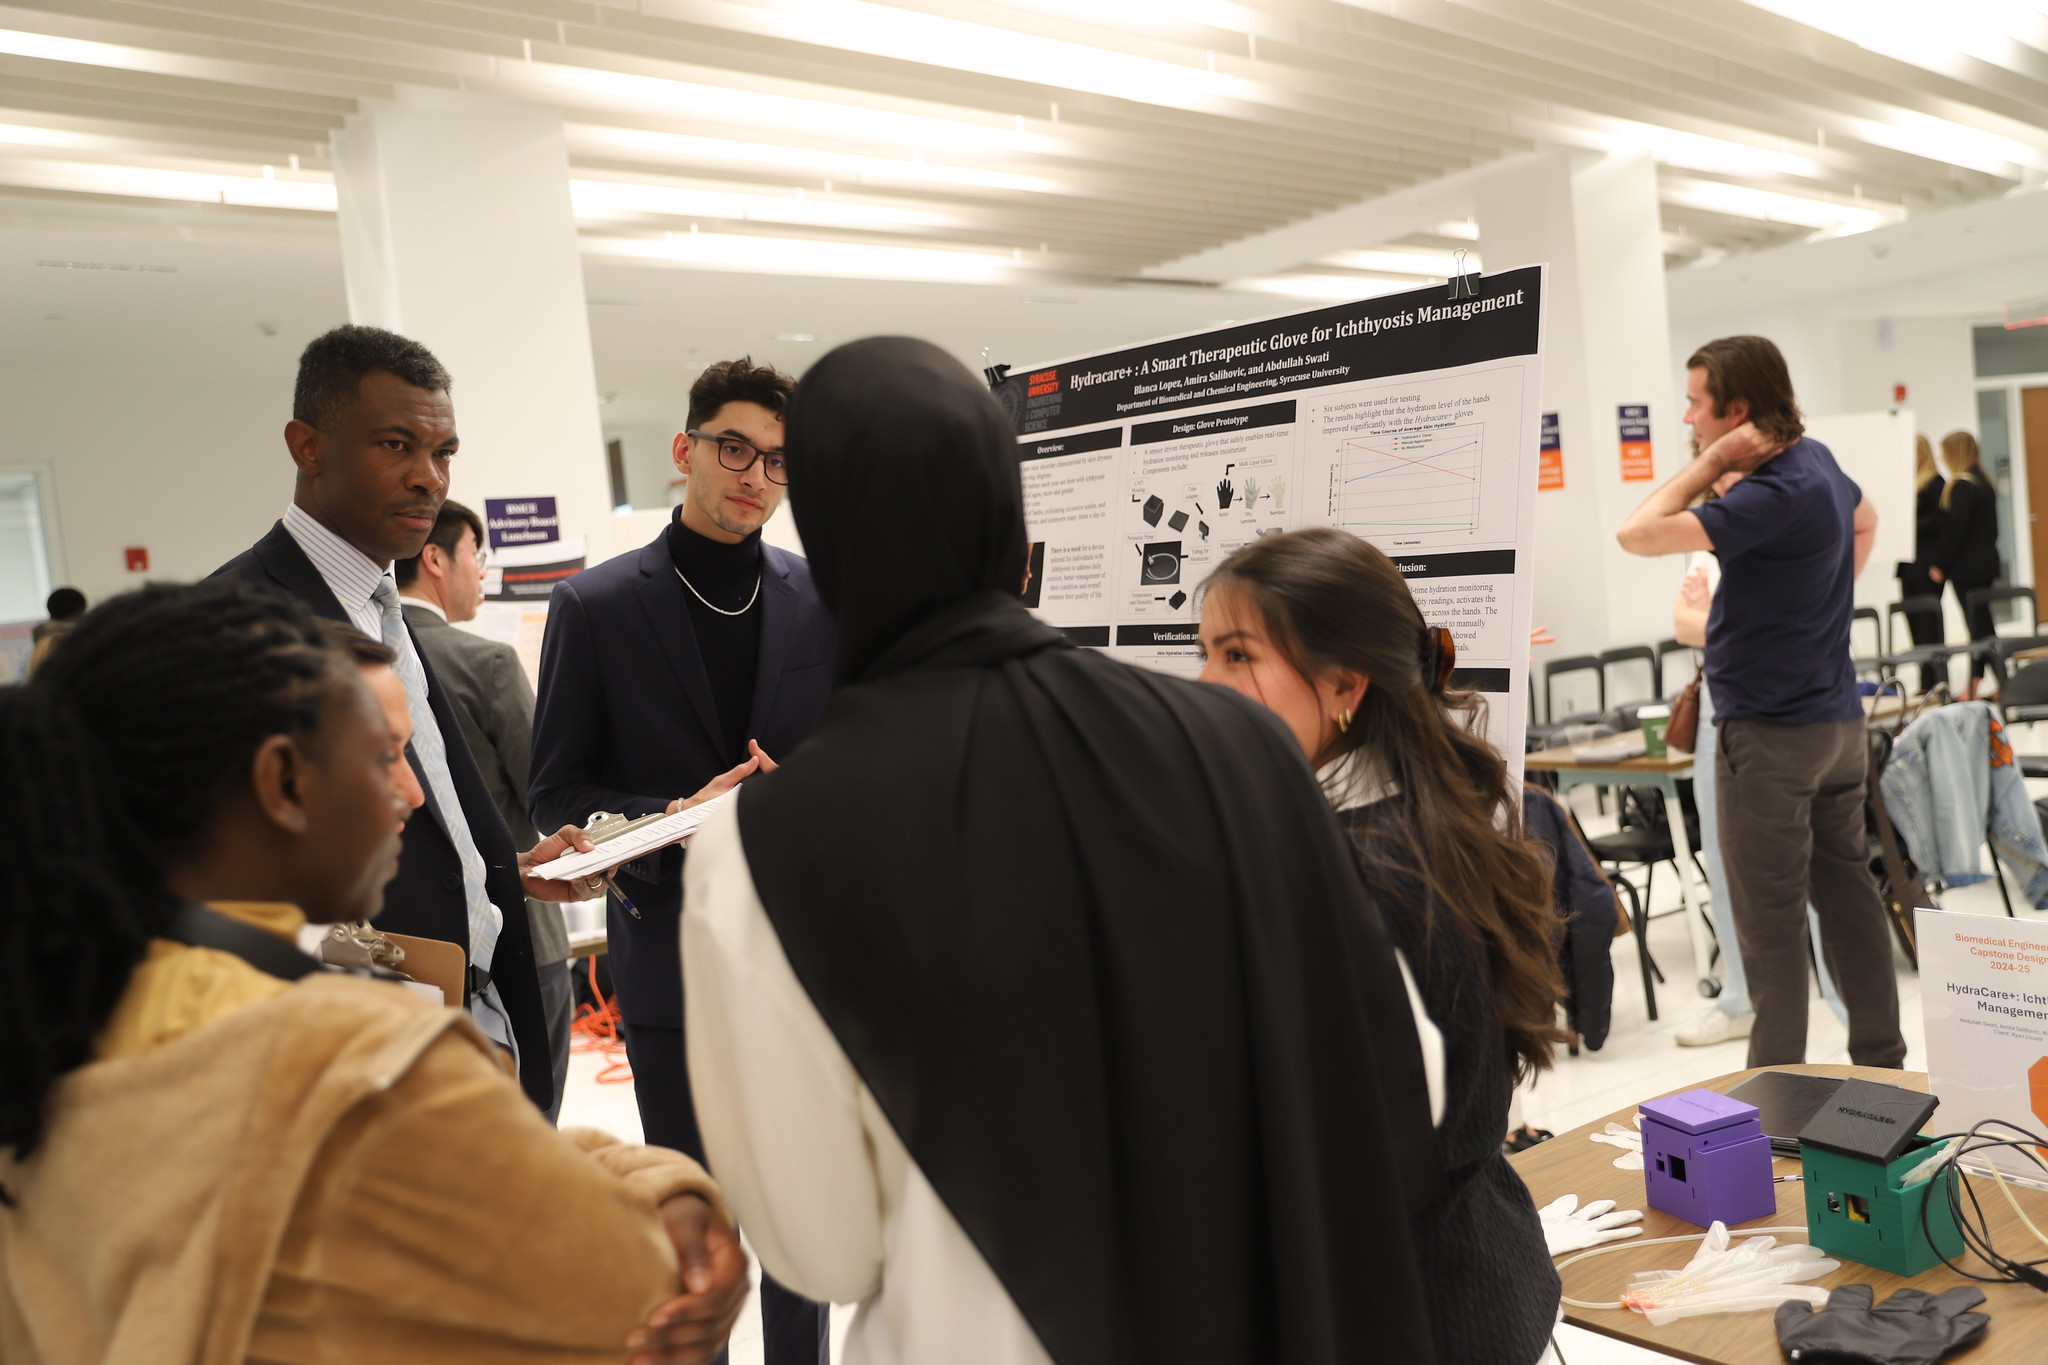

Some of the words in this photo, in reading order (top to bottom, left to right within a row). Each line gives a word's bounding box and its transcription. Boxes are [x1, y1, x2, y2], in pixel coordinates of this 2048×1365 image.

[1070, 366, 1132, 392] Hydracare+
[1141, 361, 1150, 375] A
[1152, 356, 1187, 374] Smart
[1190, 338, 1267, 366] Therapeutic
[1270, 333, 1308, 350] Glove
[1311, 326, 1332, 343] for
[1336, 310, 1414, 339] Ichthyosis
[1417, 289, 1524, 324] Management
[1029, 370, 1056, 386] SYRACUSE
[1134, 381, 1158, 396] Blanca
[1159, 376, 1183, 390] Lopez,
[1184, 374, 1208, 386] Amira
[1209, 367, 1246, 382] Salihovic,
[1248, 363, 1264, 374] and
[1265, 356, 1303, 372] Abdullah
[1305, 351, 1330, 365] Swati
[1028, 381, 1060, 397] UNIVERSITY
[1116, 398, 1150, 412] Department
[1151, 397, 1158, 406] of
[1159, 391, 1192, 404] Biomedical
[1193, 389, 1205, 399] and
[1206, 384, 1236, 397] Chemical
[1279, 372, 1310, 386] Syracuse
[1312, 365, 1350, 378] University
[1334, 402, 1357, 413] subjects
[1400, 394, 1420, 404] testing
[1334, 413, 1353, 422] results
[1355, 410, 1381, 421] highlight
[1407, 403, 1437, 415] hydration
[1438, 401, 1453, 410] level
[1462, 398, 1472, 406] the
[1472, 394, 1490, 404] hands
[1172, 424, 1196, 434] Design:
[1197, 420, 1215, 430] Glove
[1216, 415, 1249, 427] Prototype
[1322, 425, 1349, 435] improved
[1350, 420, 1386, 433] significantly
[1388, 418, 1402, 426] with
[1414, 413, 1453, 426] Hydracare+
[1454, 410, 1474, 420] gloves
[1037, 444, 1064, 454] Overview:
[1179, 442, 1204, 452] therapeutic
[1205, 439, 1218, 448] glove
[1230, 435, 1244, 445] safely
[1245, 433, 1263, 442] enables
[1264, 430, 1289, 440] real-time
[1143, 457, 1164, 466] hydration
[1165, 454, 1189, 464] monitoring
[1142, 467, 1170, 476] Components
[1396, 563, 1426, 572] lusion:
[1429, 584, 1456, 594] hydration
[1458, 583, 1493, 592] monitoring
[1414, 598, 1426, 607] idity
[1429, 597, 1454, 606] readings,
[1456, 595, 1483, 604] activates
[1426, 620, 1448, 628] mpared
[1456, 619, 1486, 628] manually
[1153, 632, 1190, 641] Verification
[1955, 933, 2006, 947] Biomedical
[2008, 939, 2048, 952] Engineer
[1970, 947, 2014, 960] Capstone
[1990, 961, 2030, 973] 2024-25
[1946, 982, 2020, 1002] HydraCare+:
[2023, 993, 2048, 1005] Icht
[1977, 1001, 2048, 1020] Managemen
[1960, 1018, 1982, 1026] Abdullah
